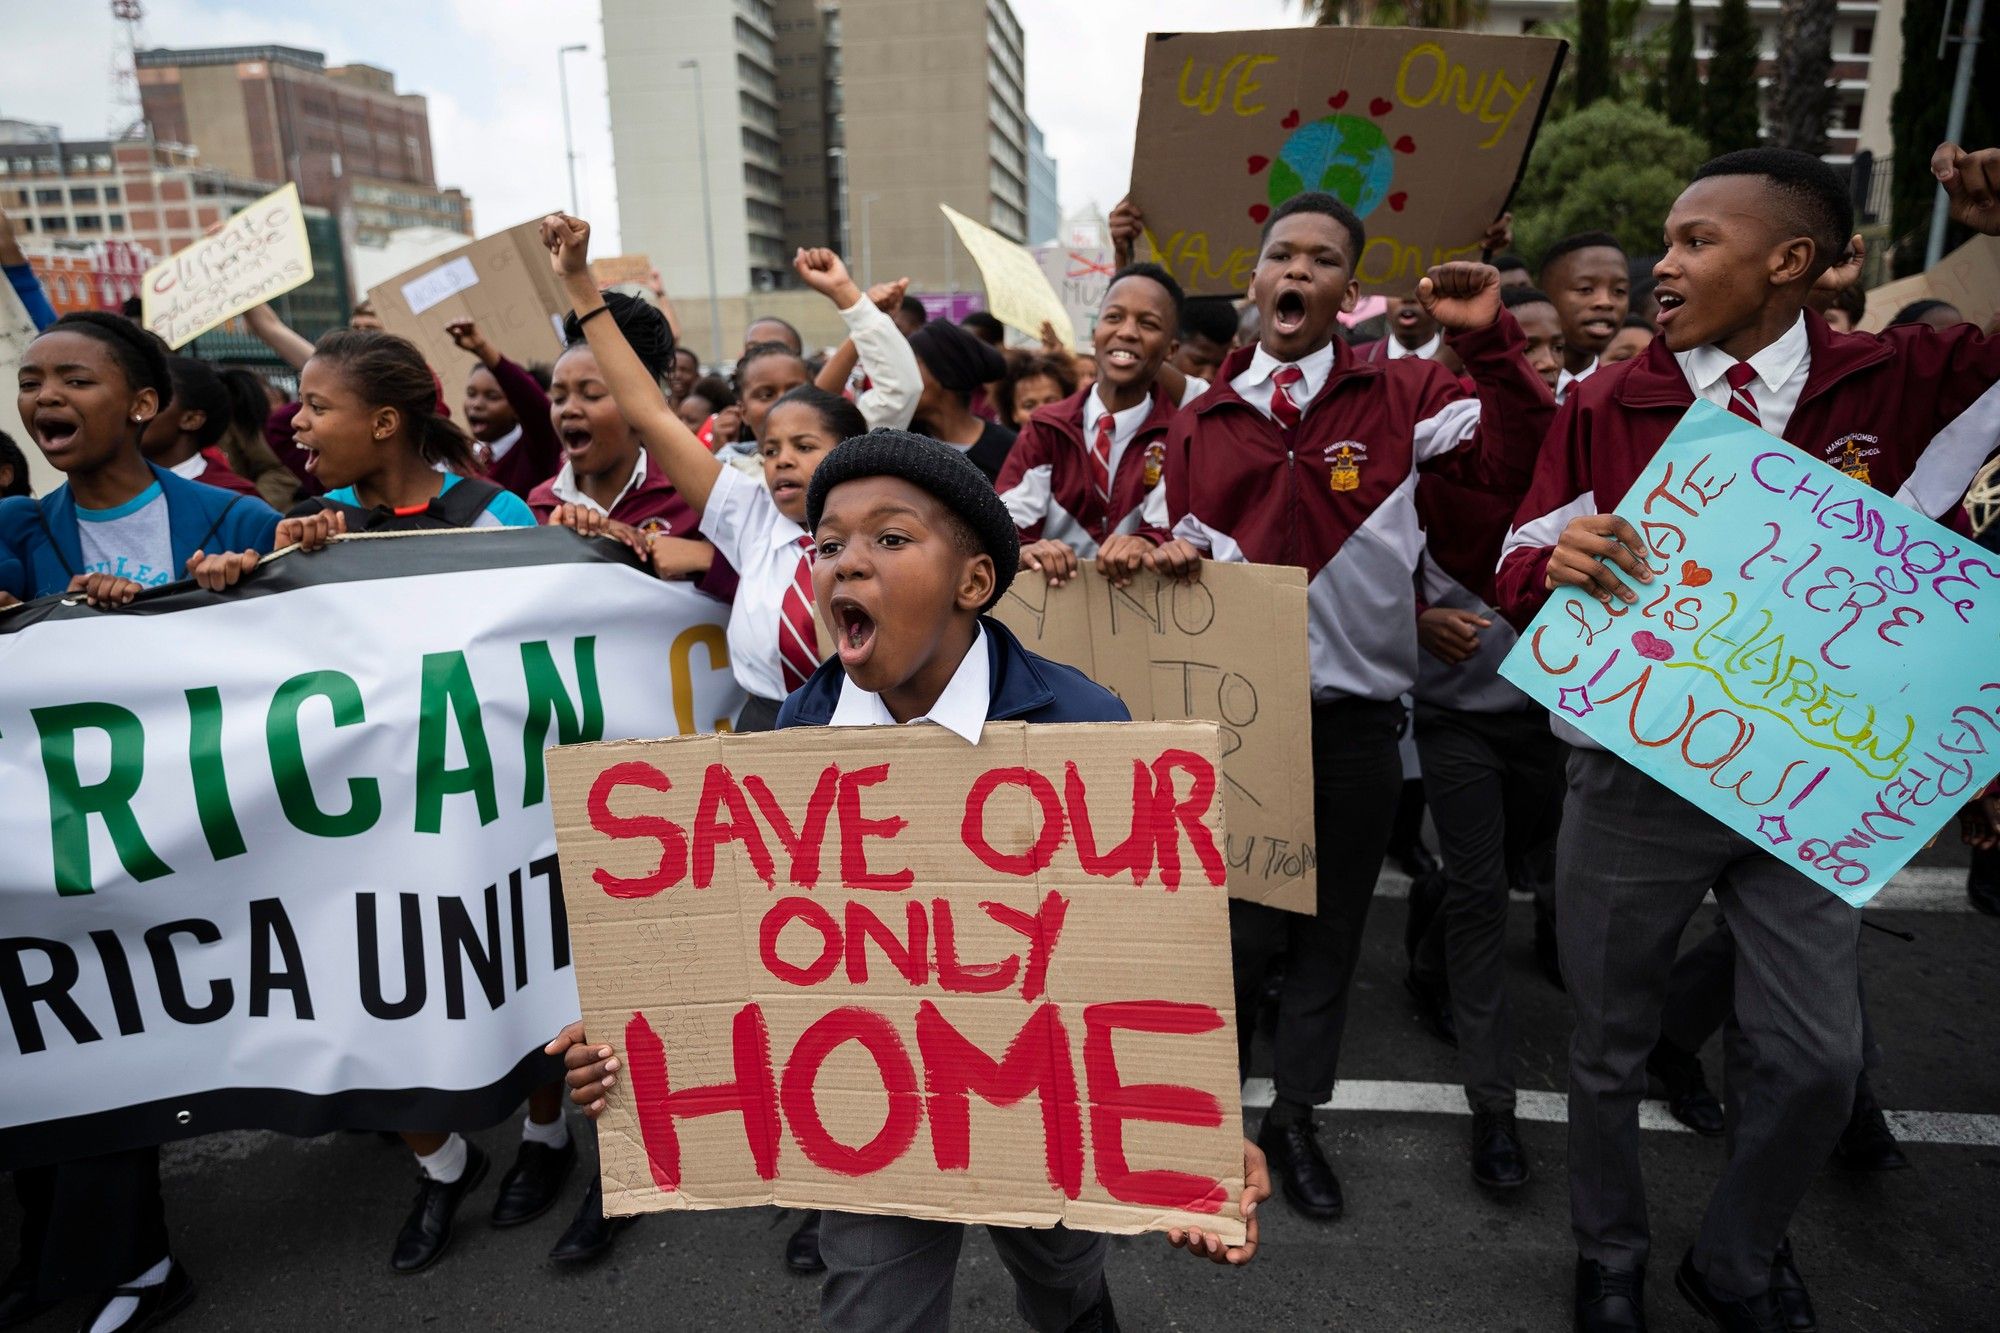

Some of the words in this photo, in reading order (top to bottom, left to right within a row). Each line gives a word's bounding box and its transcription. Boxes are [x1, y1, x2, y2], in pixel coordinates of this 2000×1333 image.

[1177, 53, 1279, 117] WE
[157, 258, 305, 343] lassrooms
[1826, 456, 1844, 465] HIGH
[1857, 447, 1882, 458] SCHOOL
[1108, 579, 1215, 635] NO
[1531, 453, 1737, 675] CLATE
[1751, 452, 2000, 623] CHANGE
[1740, 521, 1925, 669] HERE
[1151, 660, 1258, 727] TO
[0, 636, 602, 897] RICAN
[587, 761, 914, 899] SAVE
[961, 748, 1227, 892] OUR
[1, 898, 315, 1055] RICA
[356, 853, 571, 1021] UNIT
[759, 890, 1069, 1003] ONLY
[625, 1000, 1228, 1214] HOME
